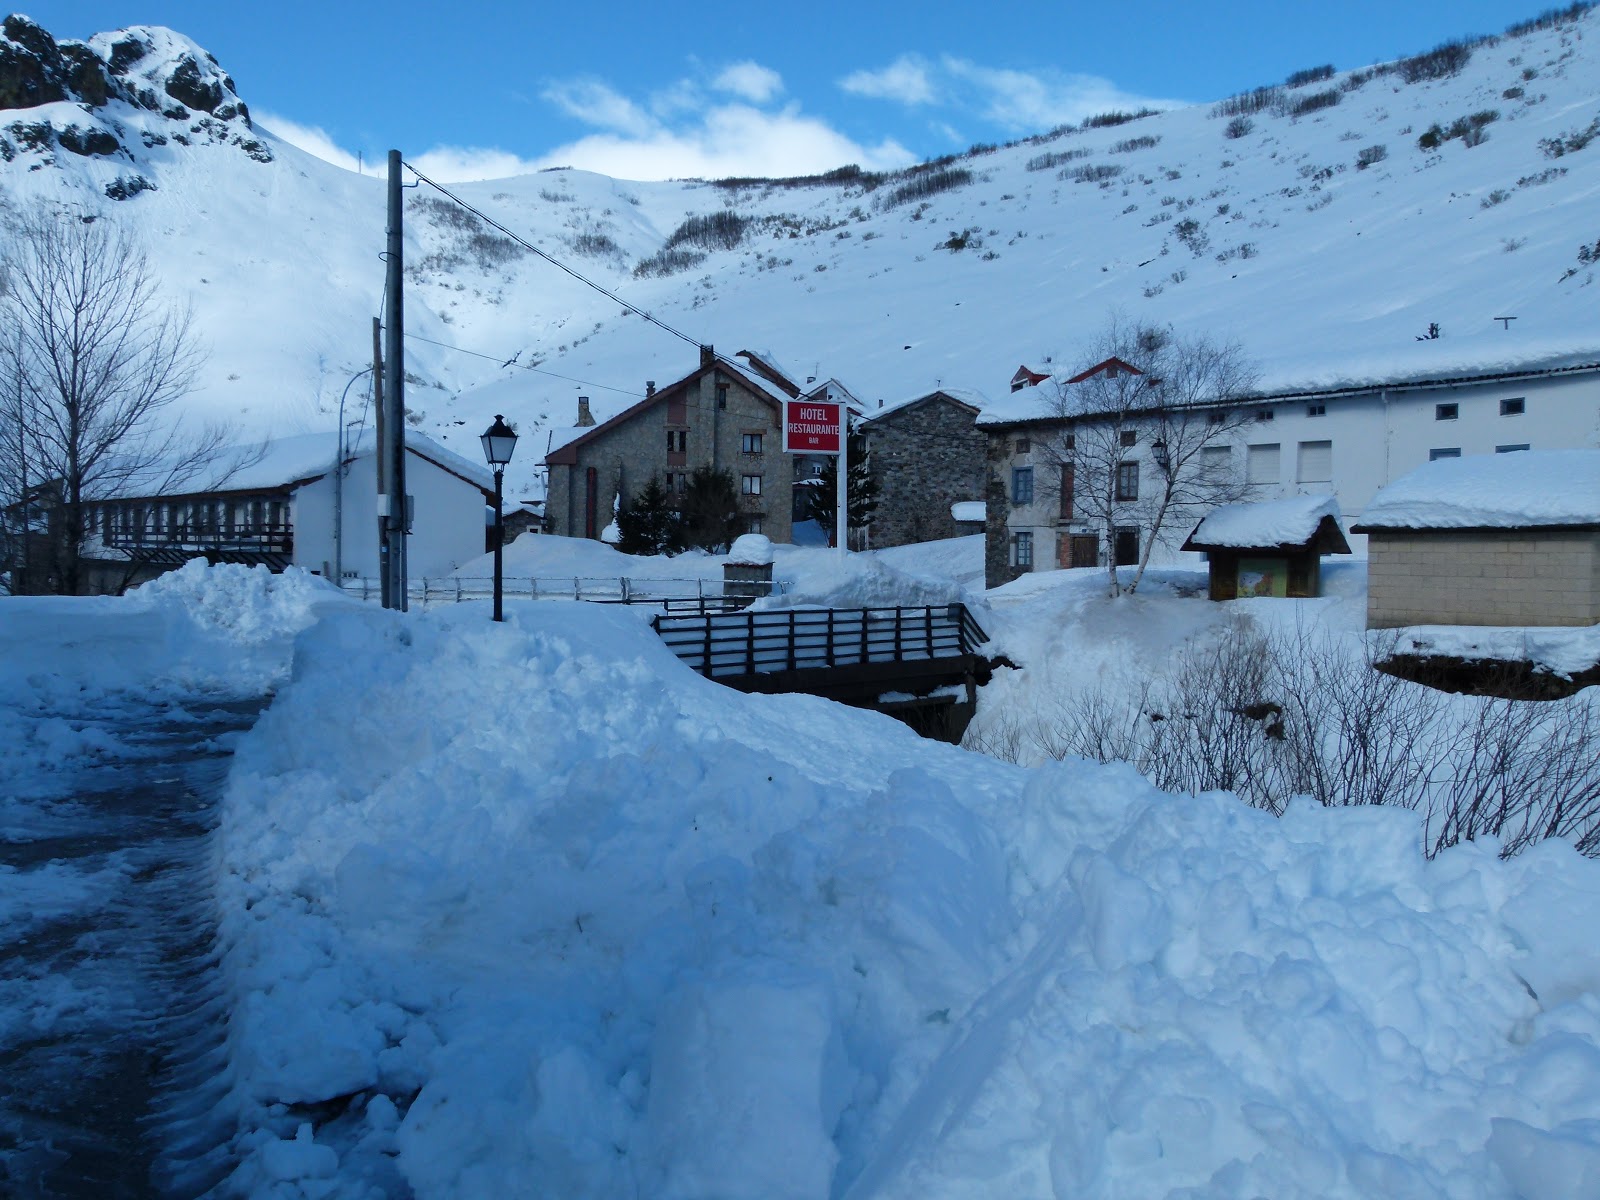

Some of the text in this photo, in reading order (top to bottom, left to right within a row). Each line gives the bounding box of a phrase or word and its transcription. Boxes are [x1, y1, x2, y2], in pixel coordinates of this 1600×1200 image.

[800, 408, 828, 421] HOTEL
[788, 422, 840, 436] RESTAURANTE
[808, 436, 820, 445] BAR
